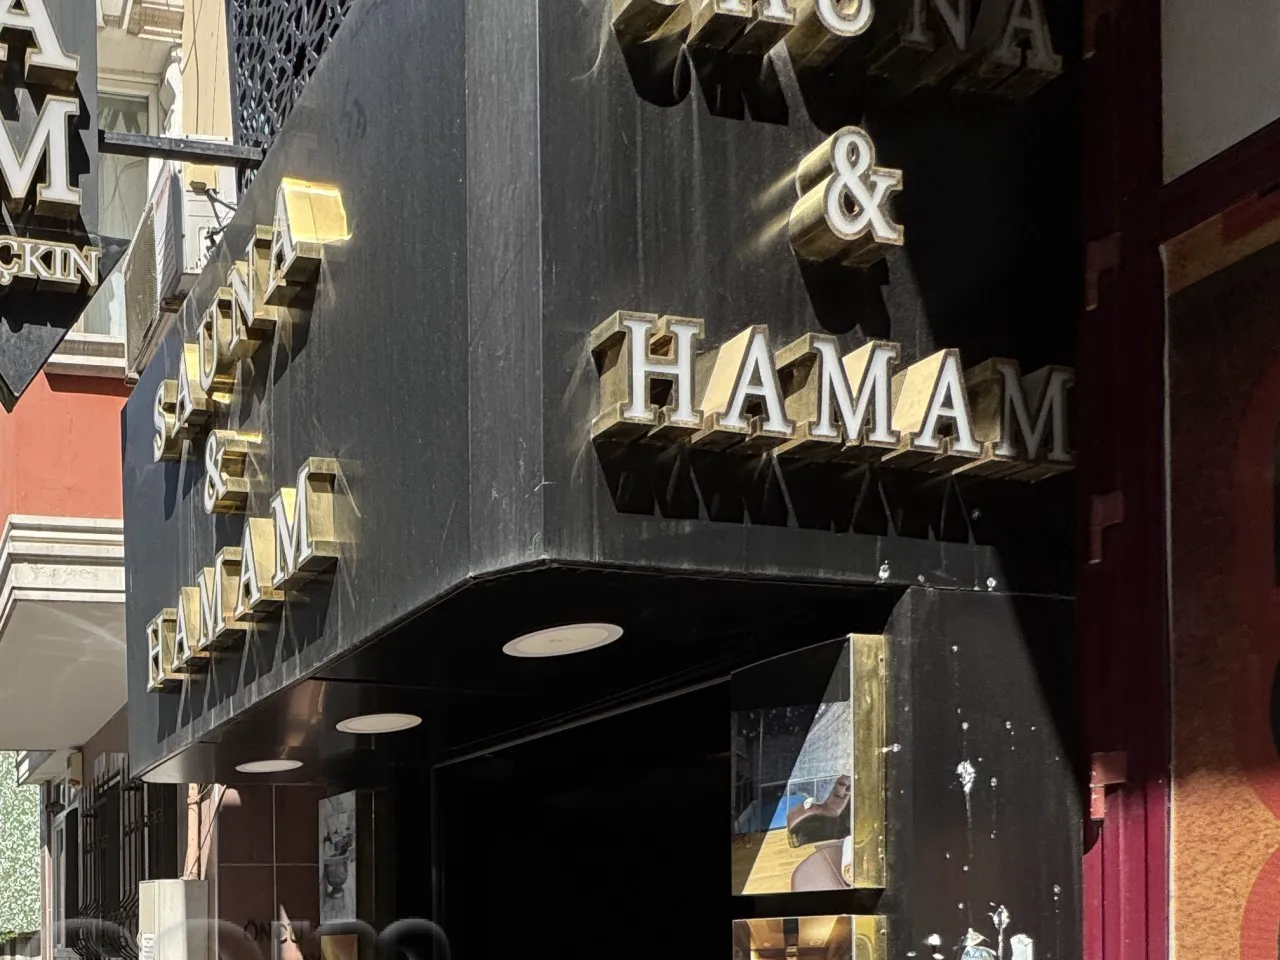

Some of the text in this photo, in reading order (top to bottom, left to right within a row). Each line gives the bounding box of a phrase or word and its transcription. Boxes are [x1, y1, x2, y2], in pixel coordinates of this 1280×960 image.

[812, 126, 905, 249] &
[153, 178, 317, 463] SAUNA
[616, 310, 1077, 468] HAMAM
[204, 429, 239, 514] &
[146, 458, 322, 693] HAMAM
